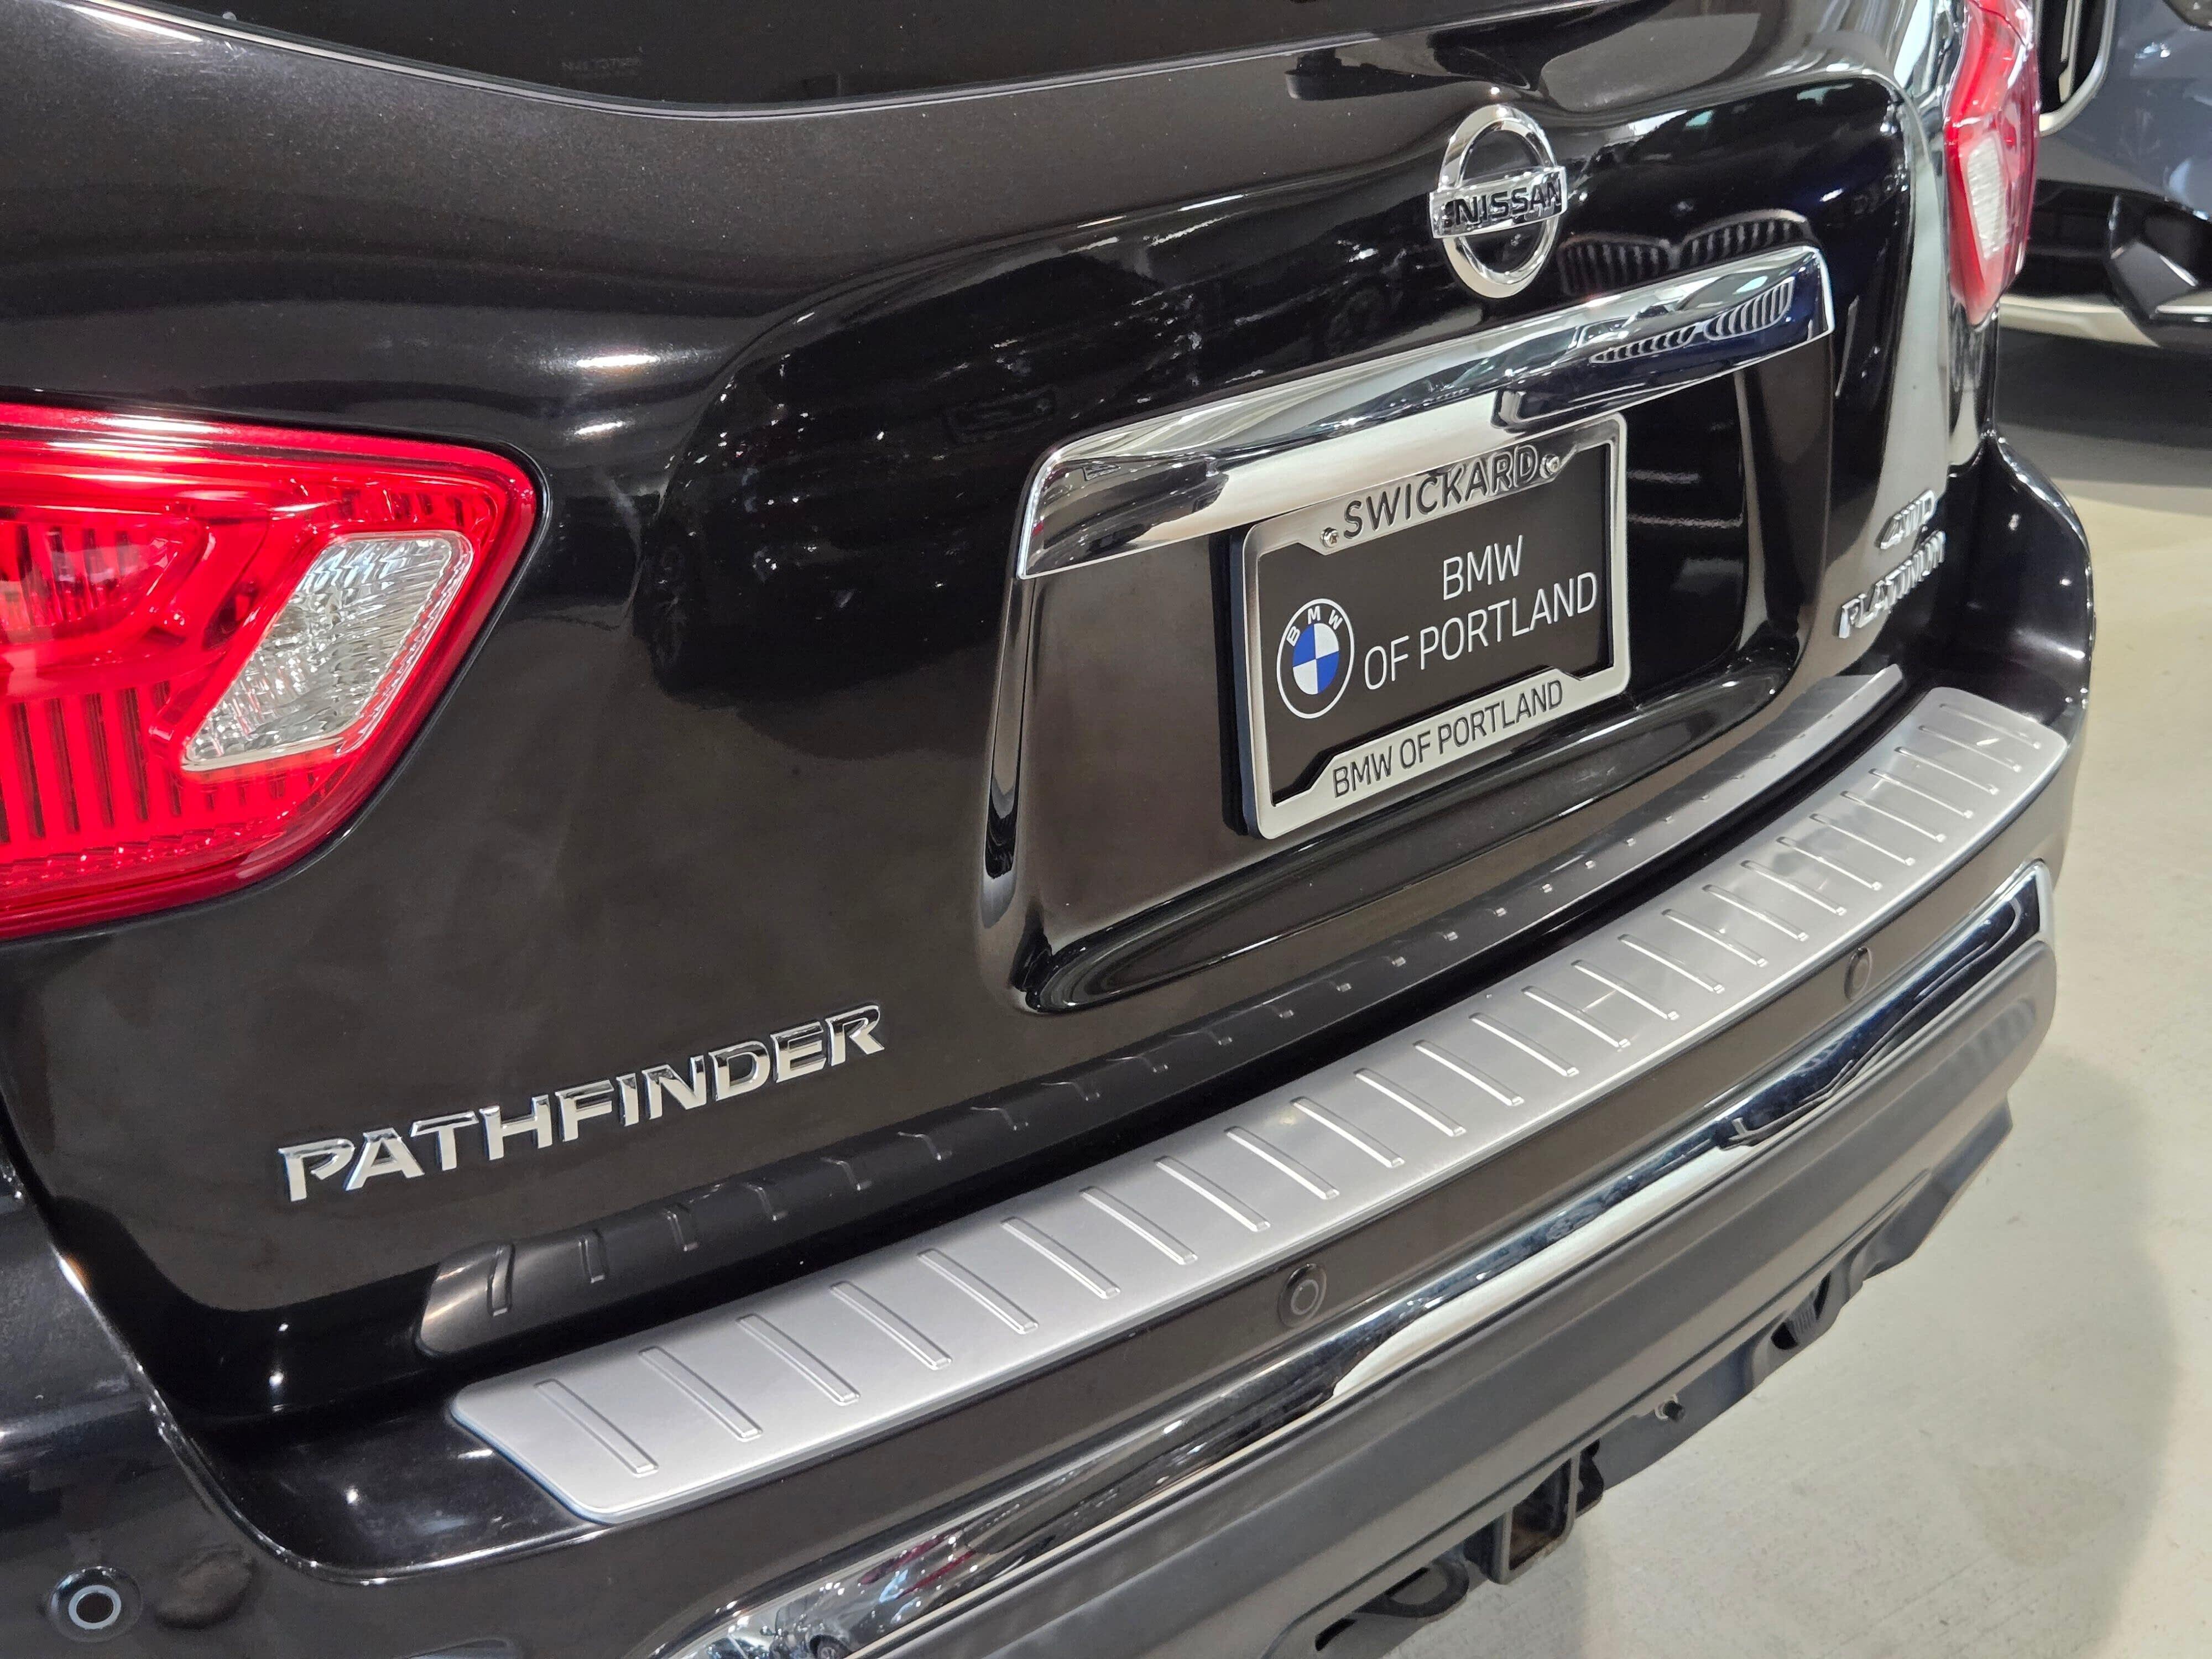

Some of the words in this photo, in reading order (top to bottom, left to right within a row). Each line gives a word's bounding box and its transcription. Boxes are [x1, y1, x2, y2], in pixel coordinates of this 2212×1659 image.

[1454, 182, 1563, 226] NISSAN
[1343, 444, 1538, 539] SWICKARD
[1442, 534, 1524, 601] BMW
[1838, 530, 1946, 639] PLATINUM
[1286, 606, 1343, 646] BMW
[1364, 635, 1410, 690] OF
[1420, 572, 1597, 670] PORTLAND
[1332, 754, 1394, 798] BMW
[1399, 731, 1431, 769] OF
[1437, 679, 1563, 756] PORTLAND
[277, 1003, 885, 1202] PATHFINDER
